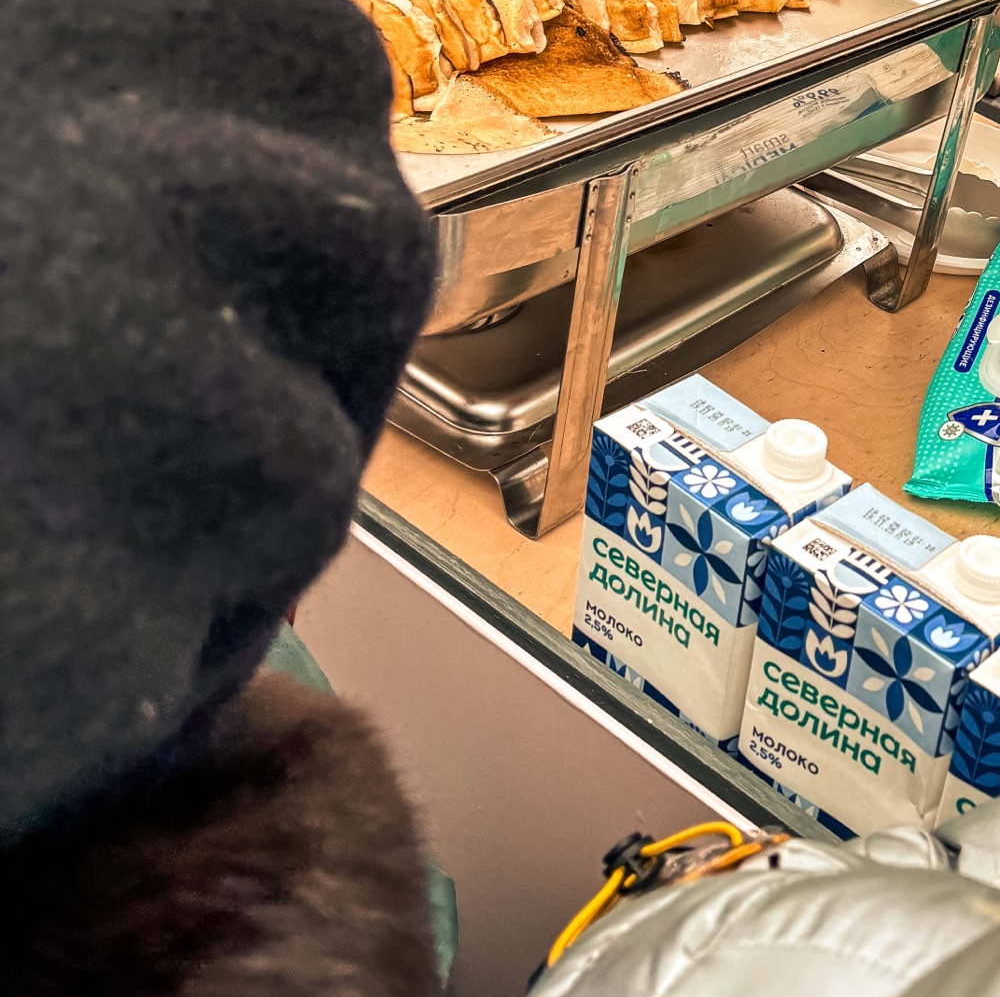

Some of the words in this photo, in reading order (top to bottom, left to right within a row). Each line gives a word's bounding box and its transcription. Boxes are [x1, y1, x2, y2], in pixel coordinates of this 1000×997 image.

[583, 613, 614, 641] 2,5%
[588, 562, 691, 649] долина
[592, 537, 721, 647] северная
[749, 739, 783, 770] 2,5%
[757, 687, 882, 775] долина
[763, 660, 917, 774] северная
